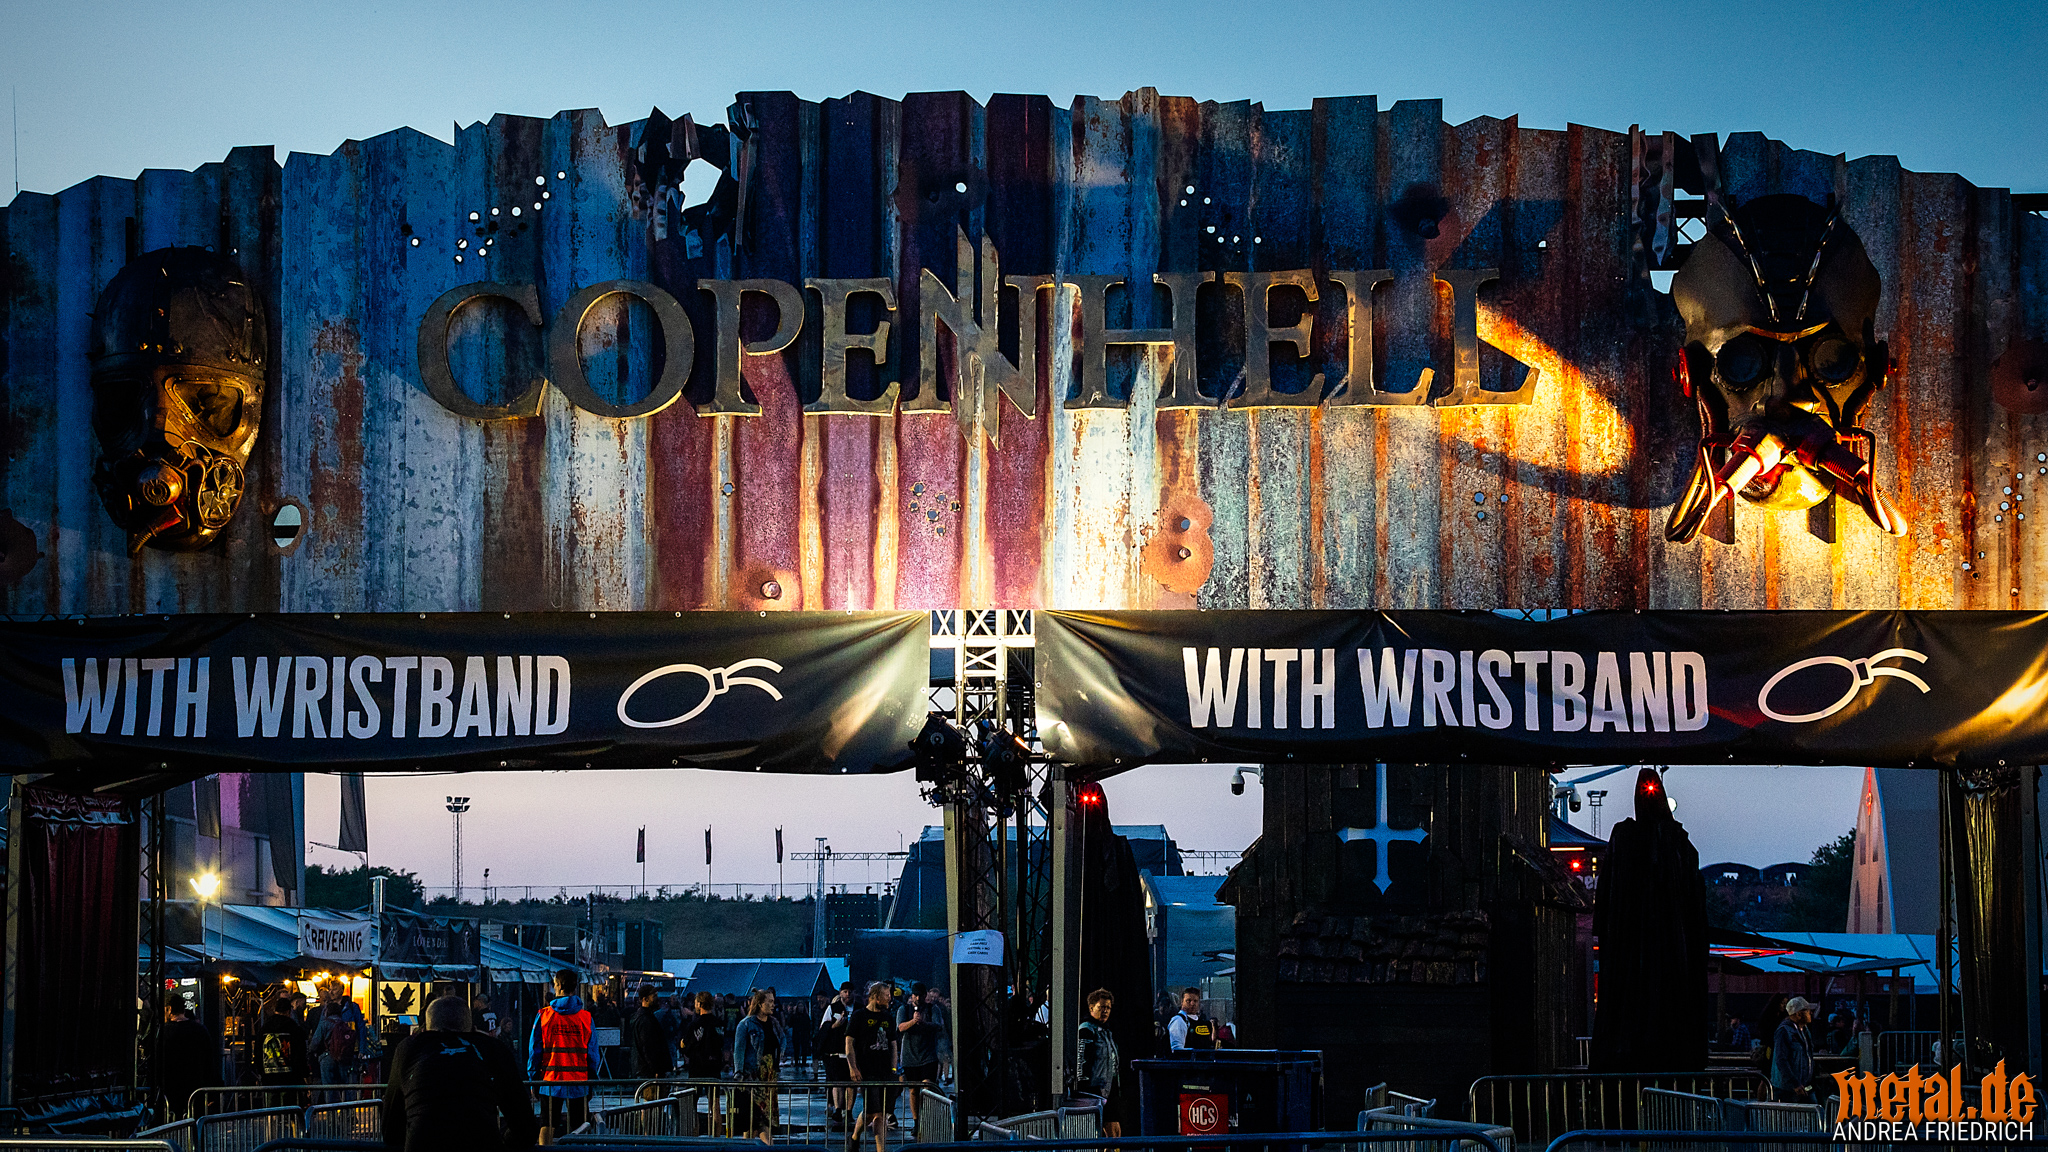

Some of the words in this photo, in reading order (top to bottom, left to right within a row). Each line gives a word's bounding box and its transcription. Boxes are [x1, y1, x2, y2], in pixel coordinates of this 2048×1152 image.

[417, 222, 1539, 452] COPENHELL
[62, 656, 210, 737] WITH
[232, 655, 571, 738] WRISTBAND
[1182, 647, 1335, 729] WITH
[1357, 648, 1709, 732] WRISTBAND
[1192, 1105, 1216, 1126] HCS
